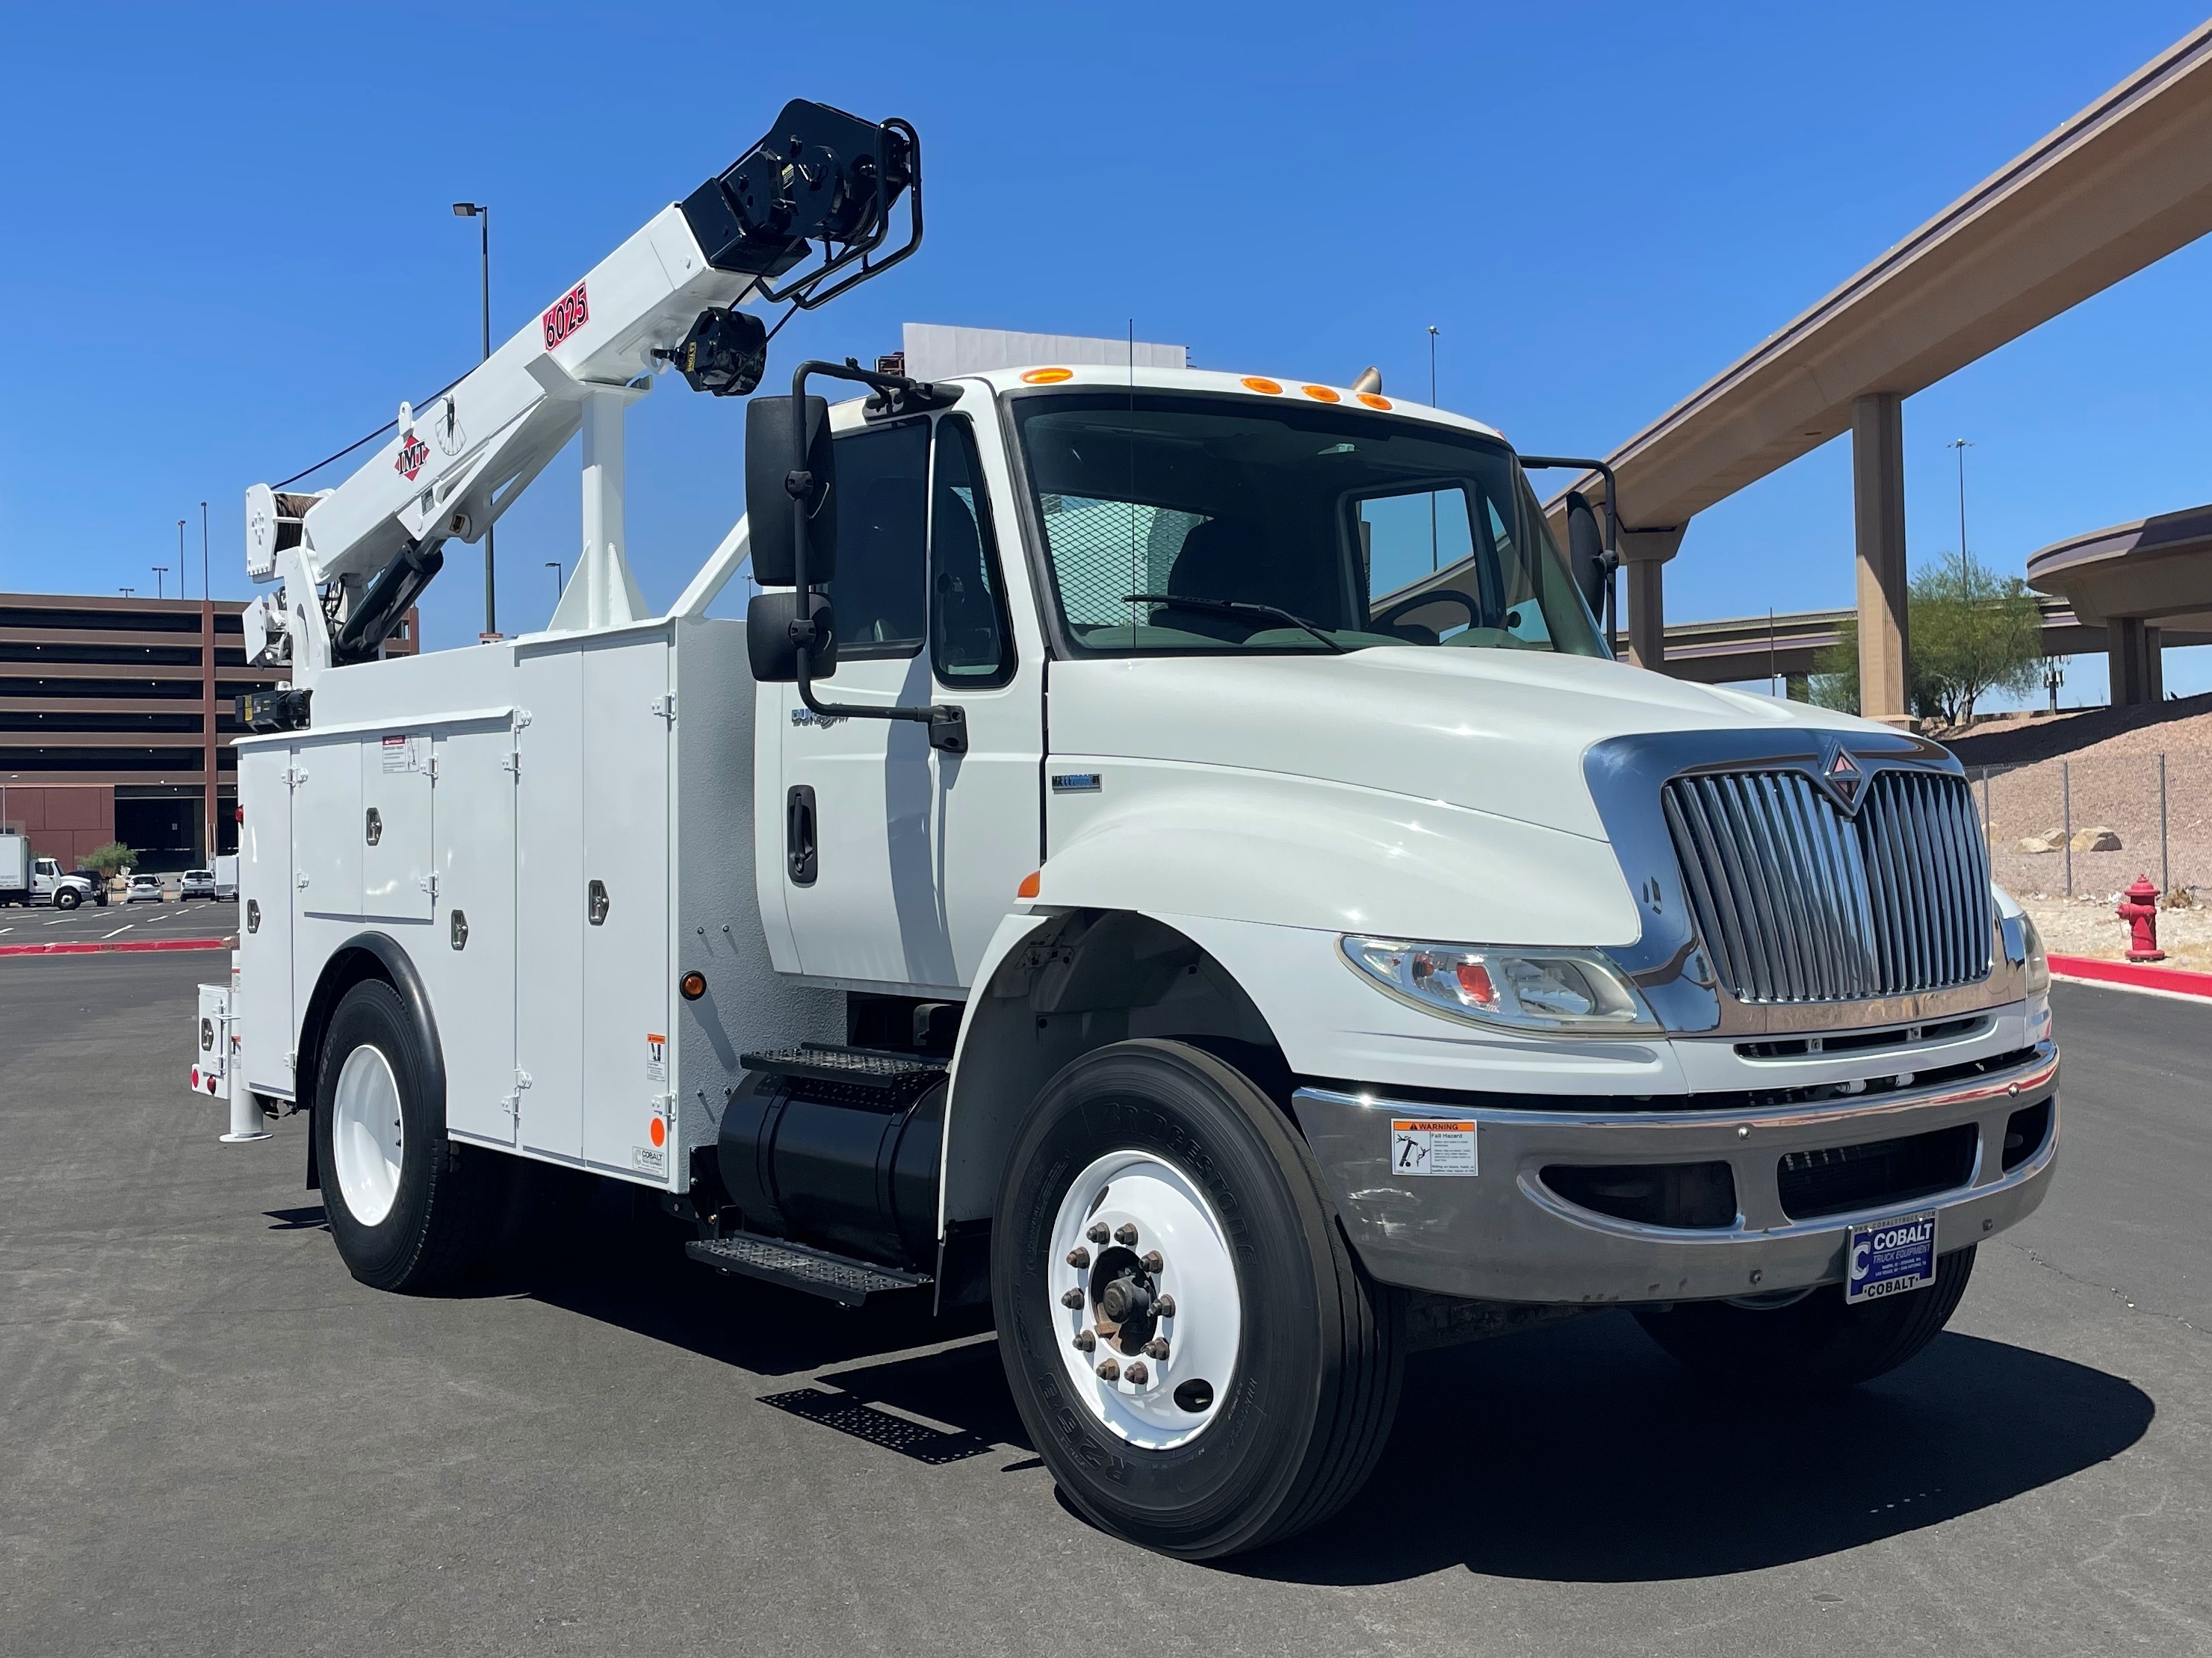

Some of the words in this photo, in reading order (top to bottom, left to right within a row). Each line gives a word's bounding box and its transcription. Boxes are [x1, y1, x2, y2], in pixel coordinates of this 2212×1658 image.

[546, 285, 586, 348] 6025
[398, 441, 426, 474] IMT
[642, 1150, 662, 1161] COBALT
[1874, 1223, 1933, 1250] COBALT
[1873, 1252, 1895, 1264] TRUCK
[1896, 1244, 1931, 1259] EQUIPMENT
[1868, 1276, 1915, 1297] COBALT
[1037, 1372, 1137, 1488] R268
